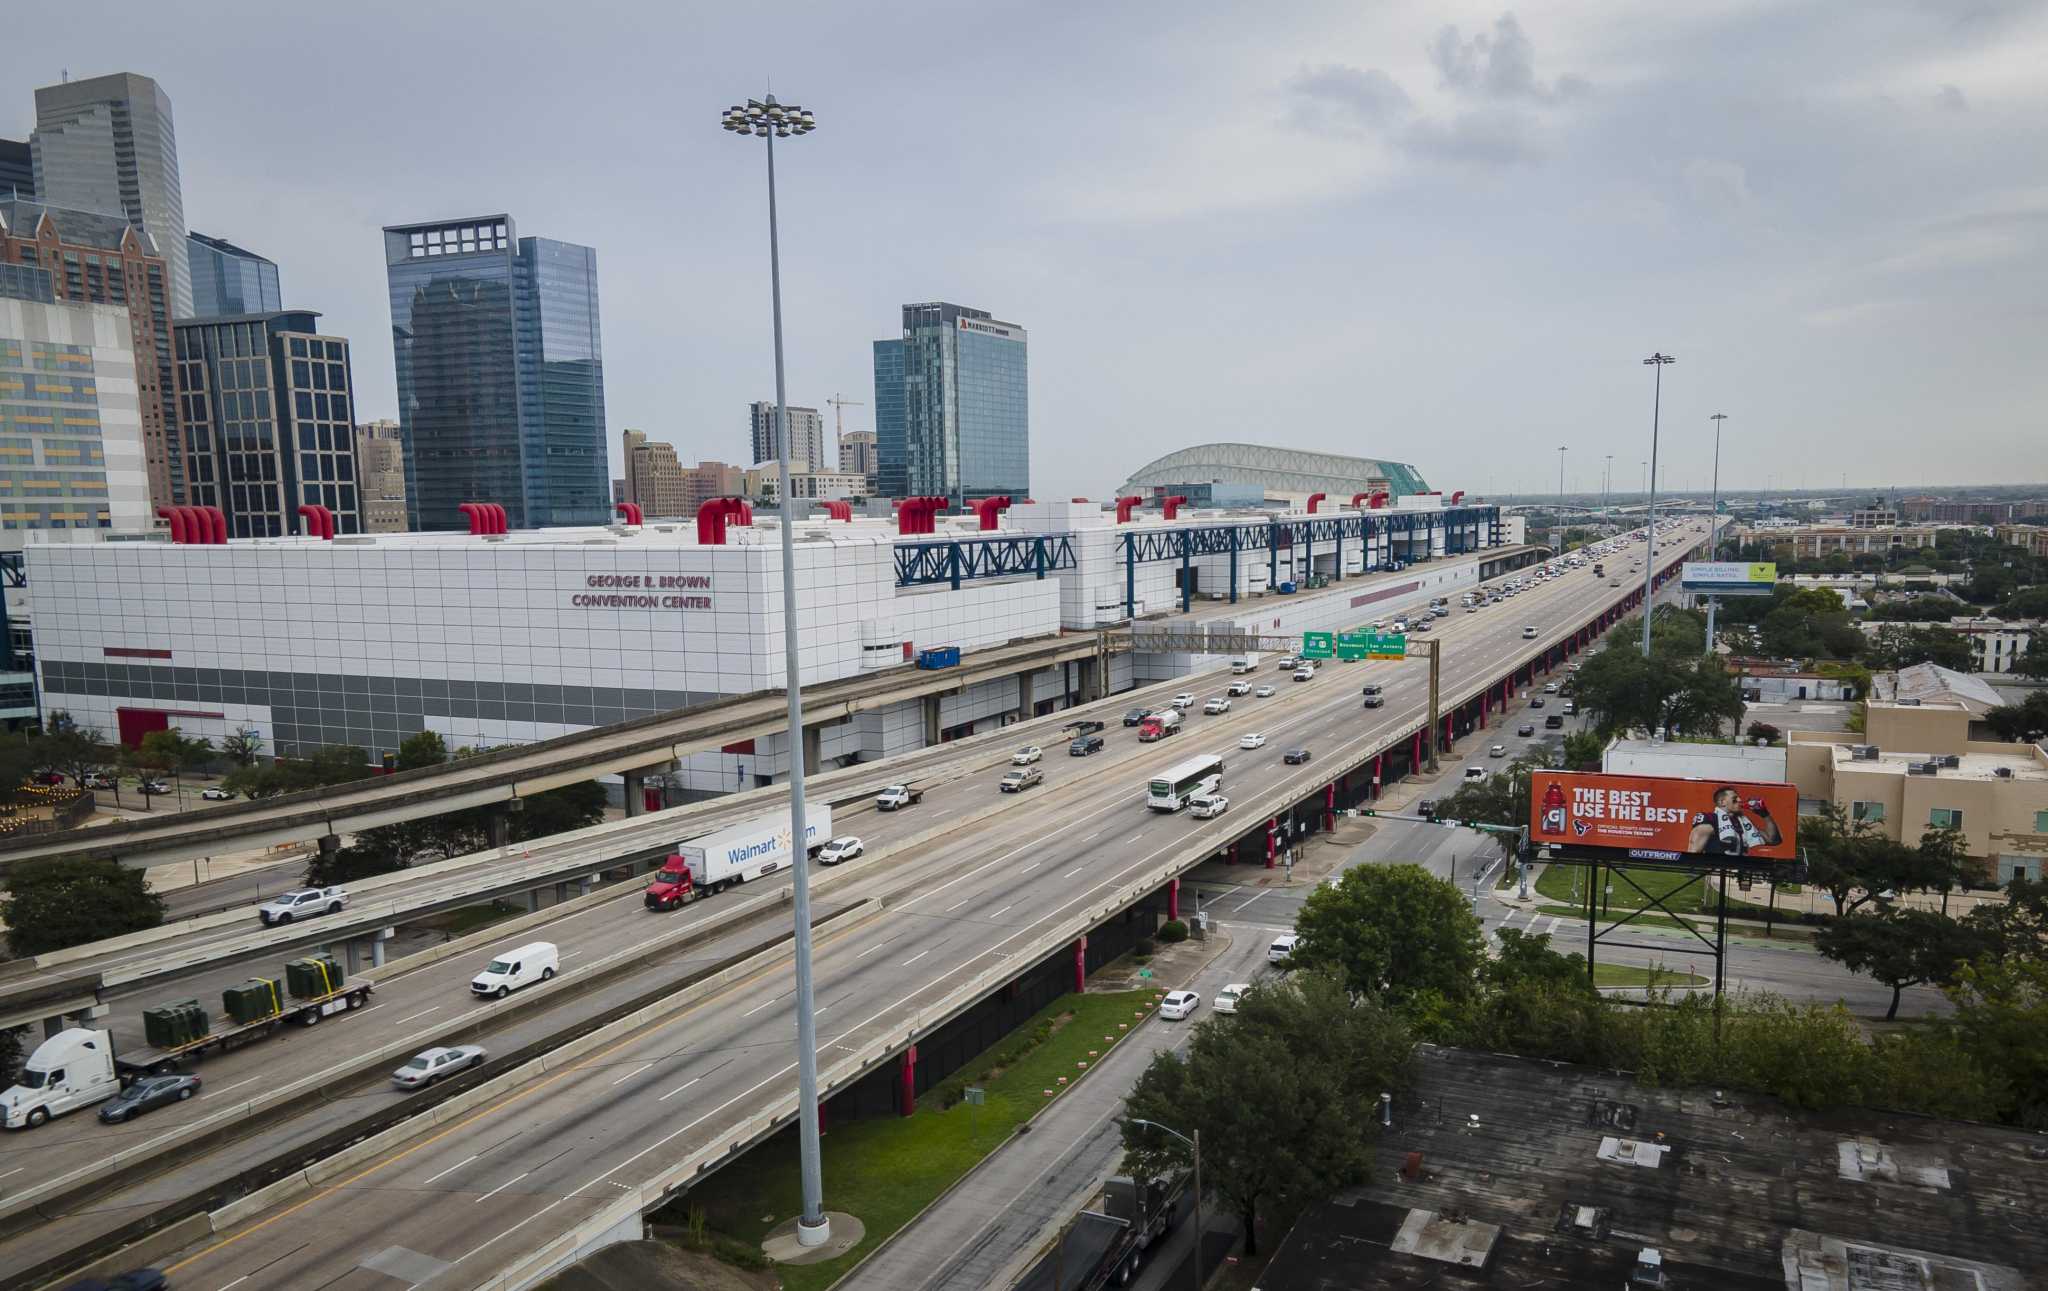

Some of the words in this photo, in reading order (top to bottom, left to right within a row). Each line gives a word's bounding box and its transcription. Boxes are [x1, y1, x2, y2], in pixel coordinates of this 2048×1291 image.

[587, 575, 640, 587] GEORGE
[644, 576, 656, 588] R.
[659, 576, 710, 588] BROWN
[572, 594, 659, 608] CONVENTION
[662, 596, 711, 609] CENTER
[1572, 787, 1606, 803] THE
[1609, 789, 1651, 806] BEST
[1549, 809, 1560, 822] G
[1572, 802, 1605, 818] USE
[1608, 804, 1641, 820] THE
[1645, 807, 1688, 824] BEST
[728, 837, 776, 864] Walmart
[1631, 850, 1677, 860] OUTFRONT
